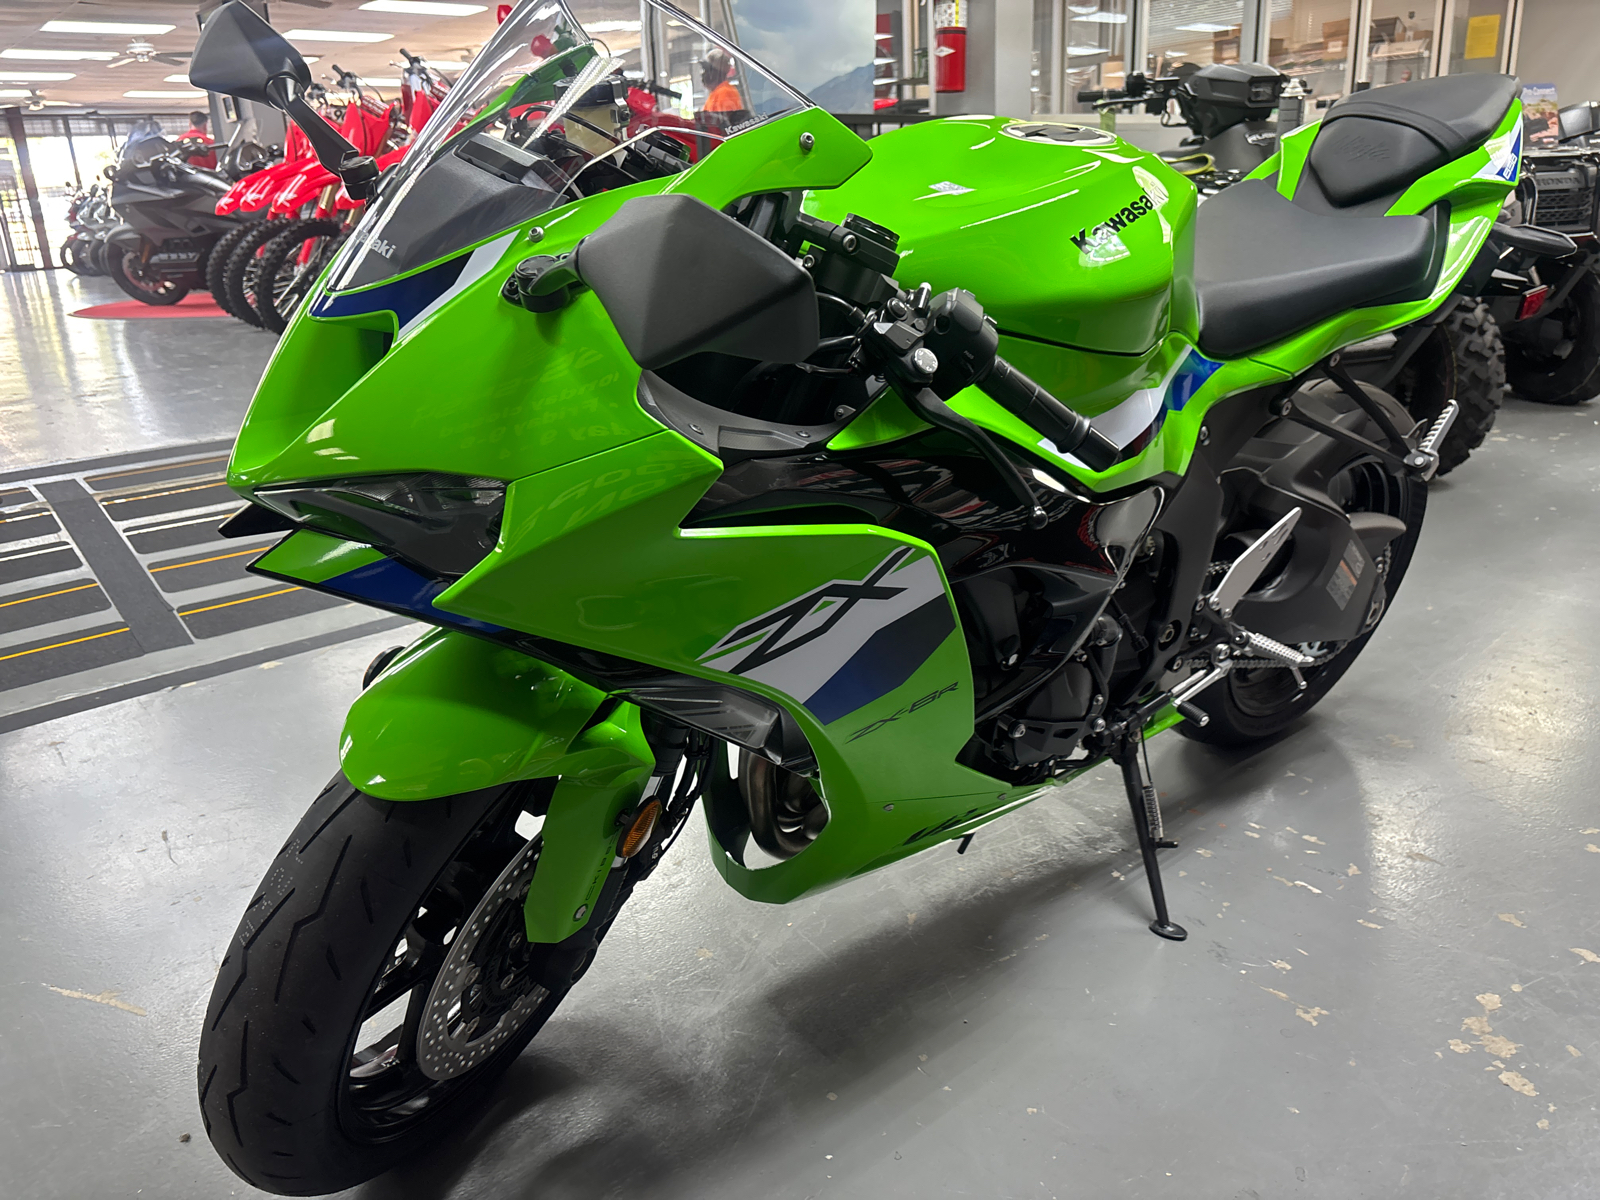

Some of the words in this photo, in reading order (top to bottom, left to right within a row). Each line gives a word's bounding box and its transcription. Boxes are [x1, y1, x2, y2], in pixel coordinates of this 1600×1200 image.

[725, 111, 769, 135] Kawasaki
[1536, 175, 1581, 187] HONDA
[700, 546, 915, 675] ZX
[843, 681, 960, 746] ZX-6R
